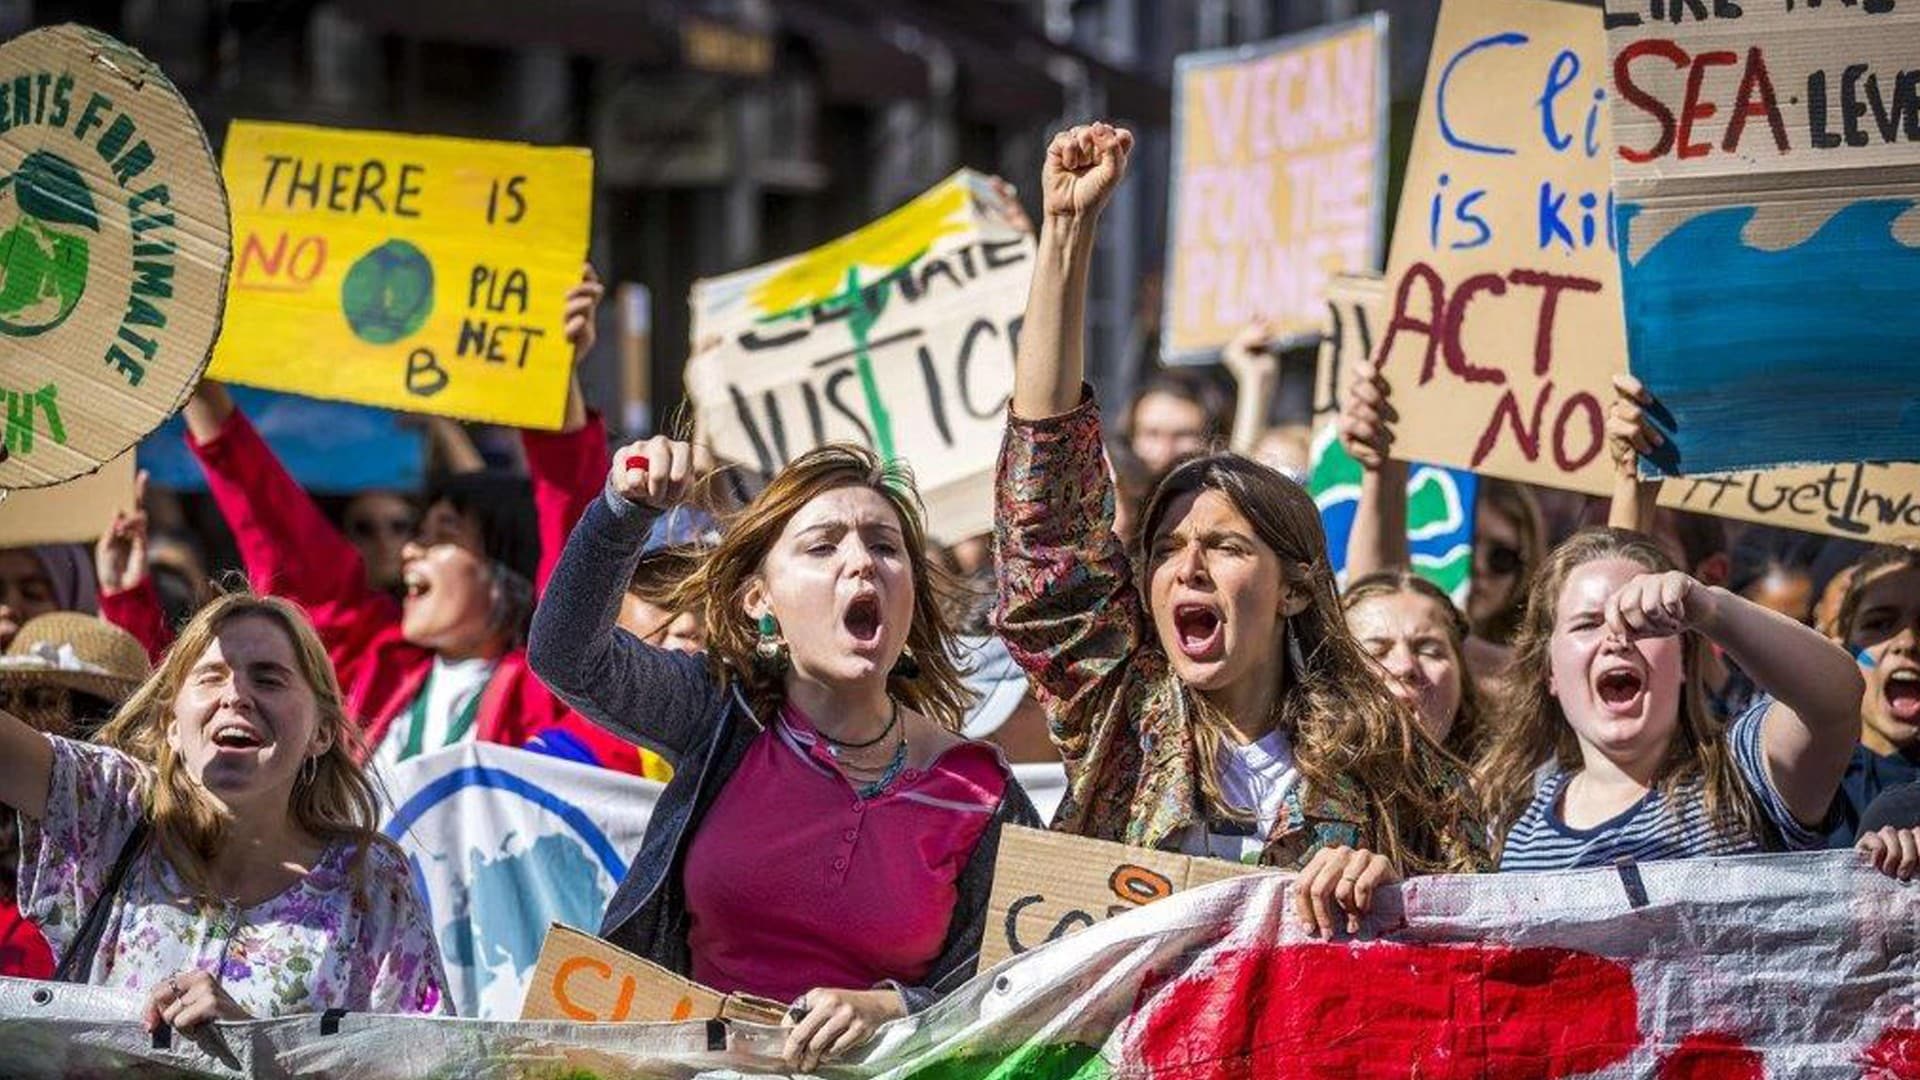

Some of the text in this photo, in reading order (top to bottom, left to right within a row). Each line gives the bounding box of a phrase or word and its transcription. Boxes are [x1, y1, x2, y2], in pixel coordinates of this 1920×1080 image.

[1202, 42, 1374, 158] VEGAN
[1613, 38, 1792, 163] SEA
[74, 92, 156, 188] FOR
[260, 155, 528, 224] THERE IS
[1431, 173, 1491, 248] is
[104, 184, 178, 386] CLIMATE
[237, 231, 328, 287] NO
[468, 264, 529, 313] PLA
[456, 318, 545, 369] NET
[1374, 262, 1603, 387] ACT
[405, 347, 449, 397] B
[0, 384, 67, 454] HT
[1470, 380, 1605, 473] NO
